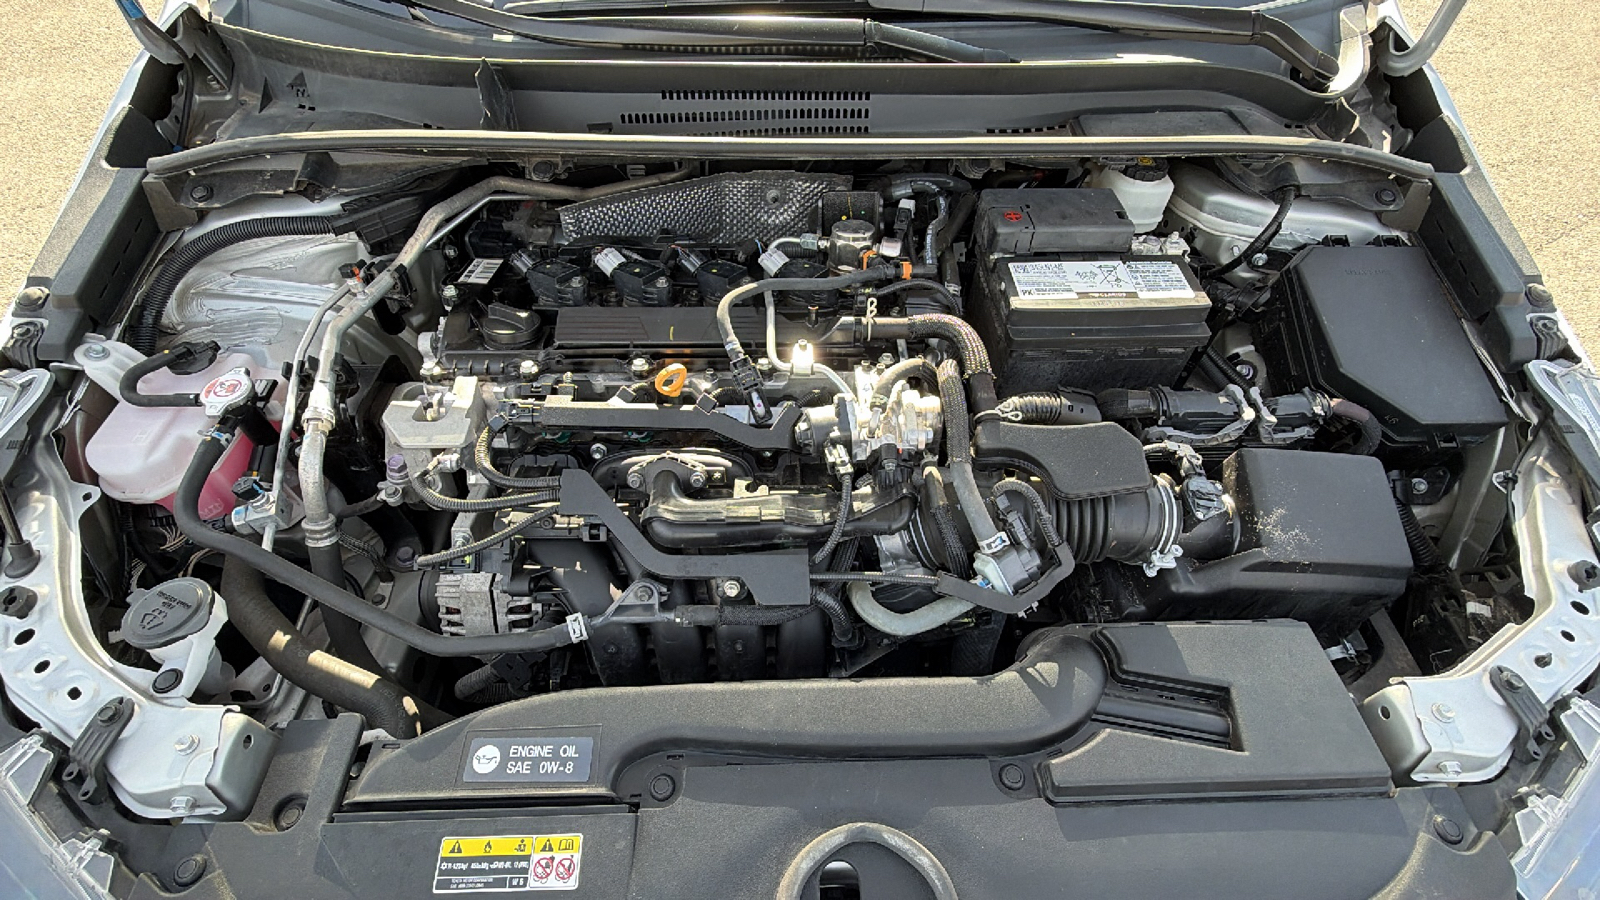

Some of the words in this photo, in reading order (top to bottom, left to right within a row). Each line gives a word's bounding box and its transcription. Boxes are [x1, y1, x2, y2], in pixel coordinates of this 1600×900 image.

[509, 745, 553, 758] ENGINE
[559, 744, 579, 758] OIL
[506, 761, 532, 774] SAE
[539, 761, 574, 774] 0W-8
